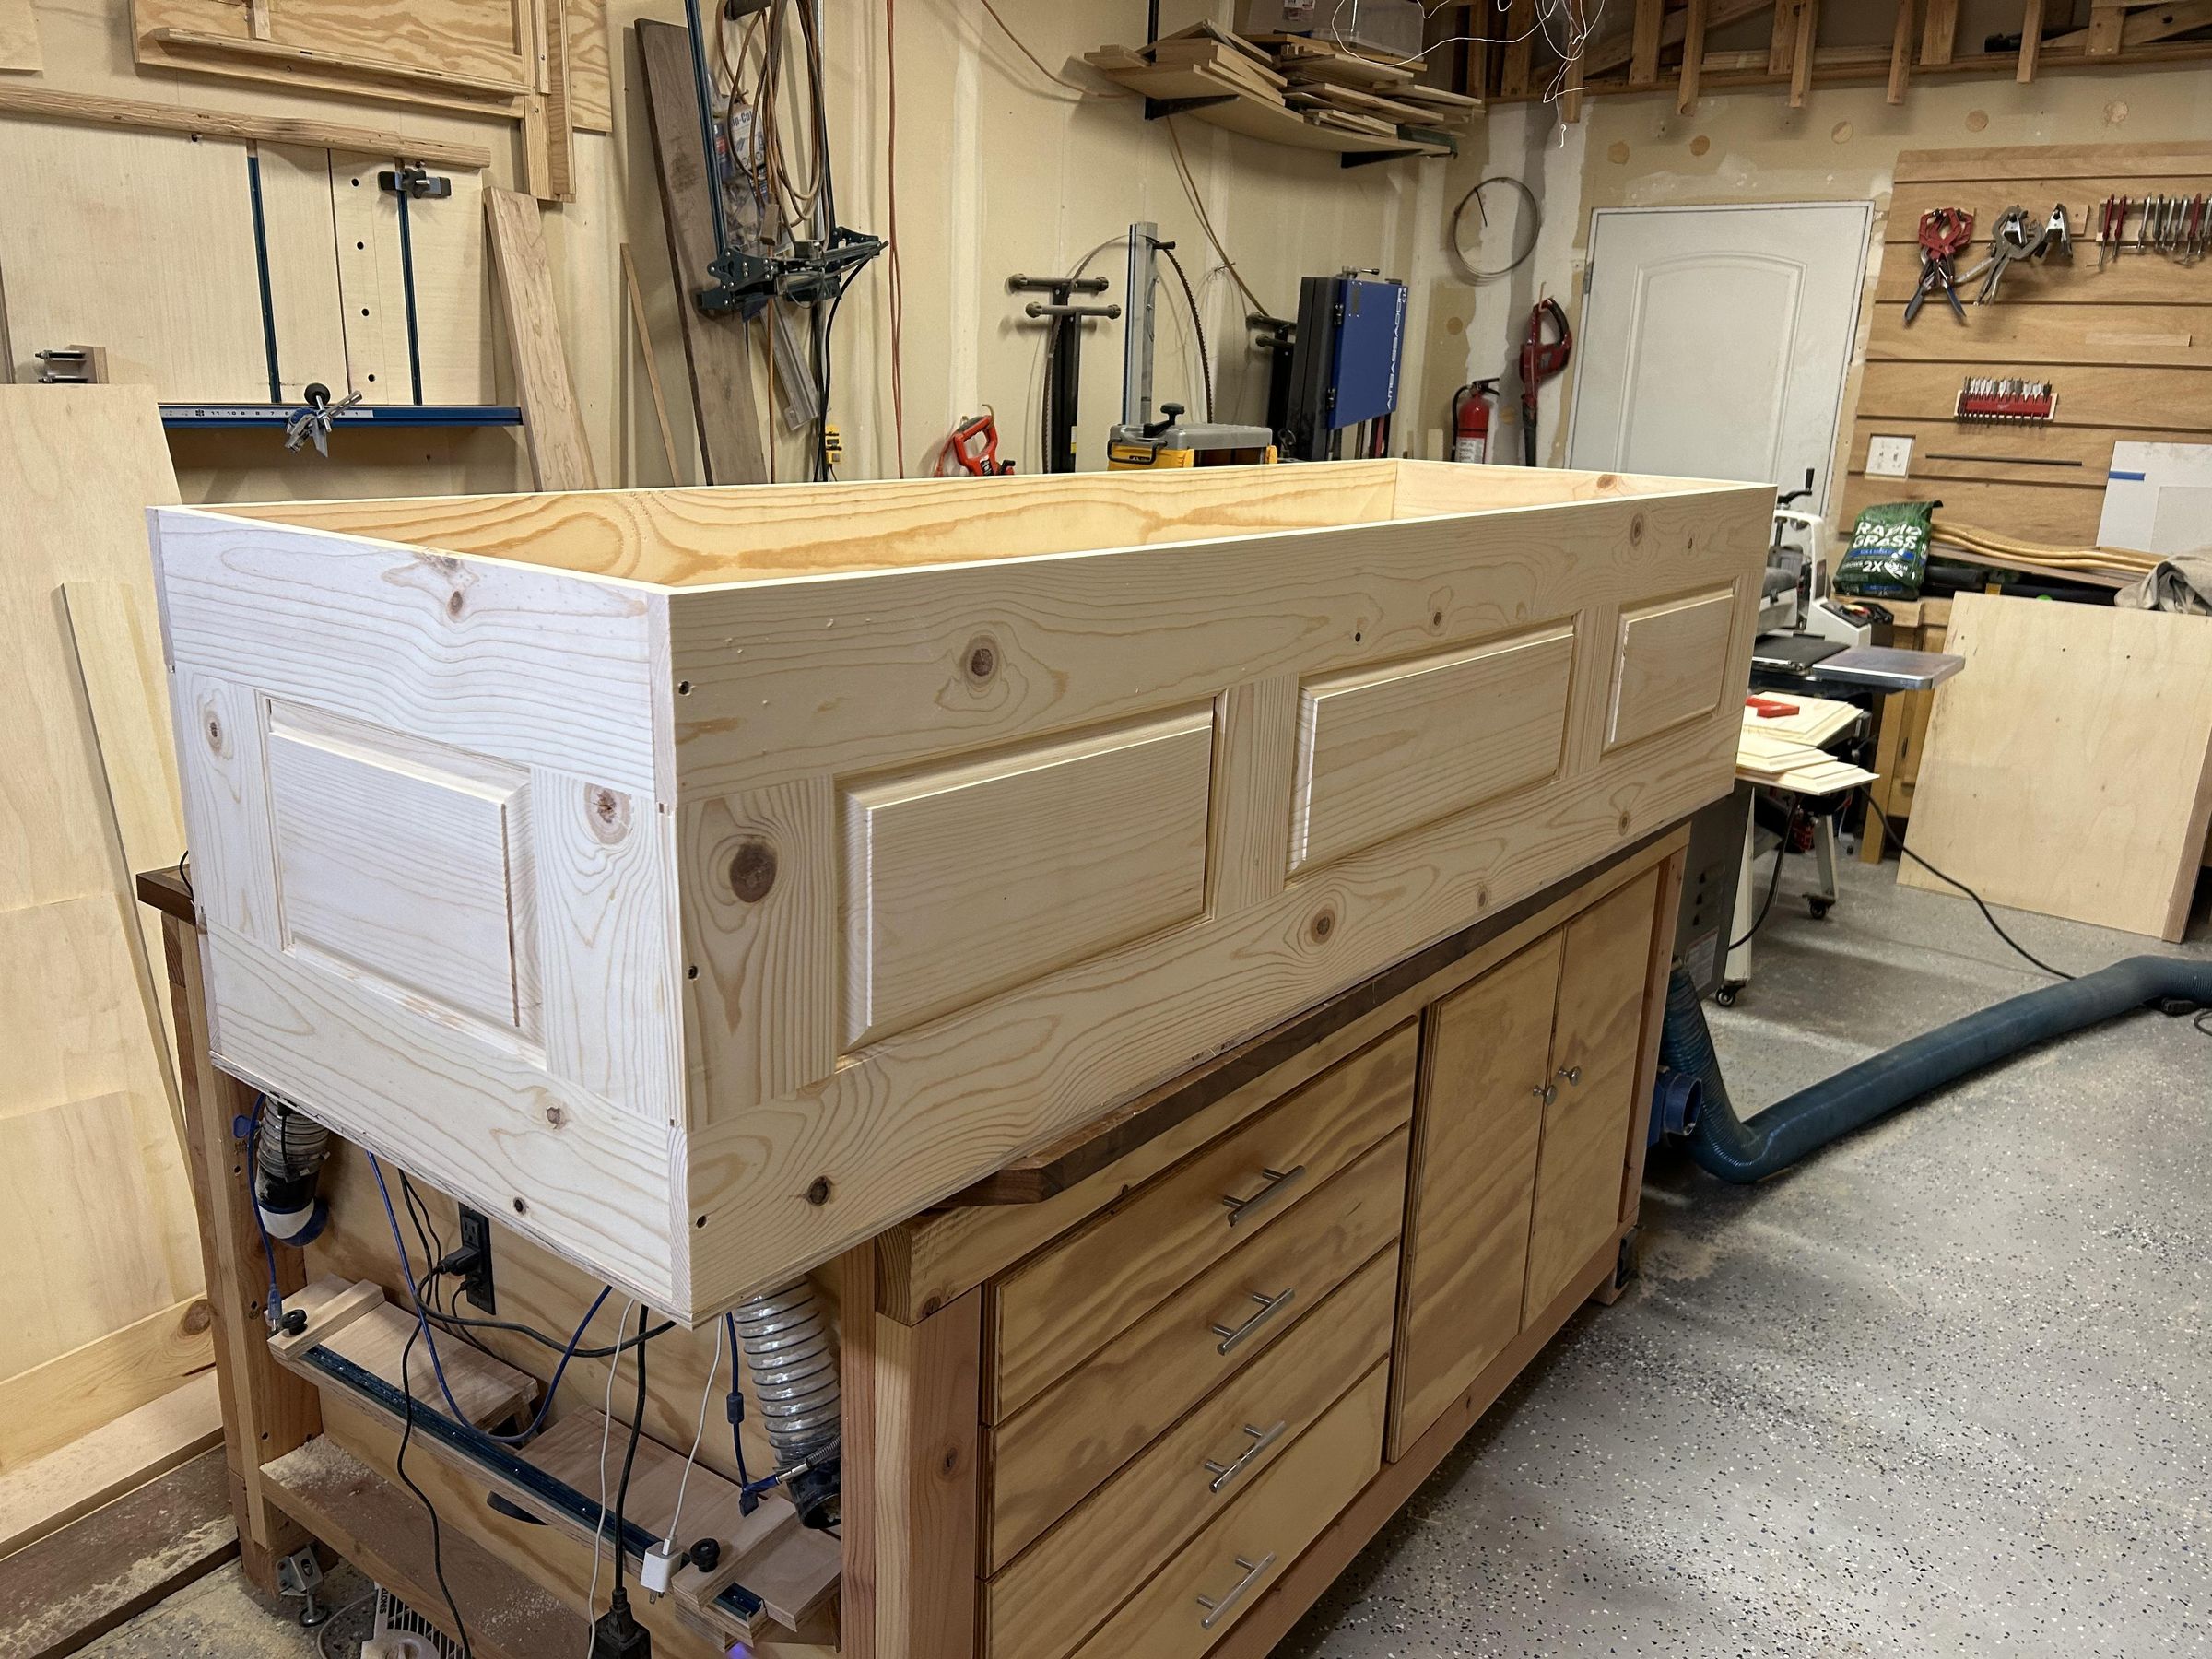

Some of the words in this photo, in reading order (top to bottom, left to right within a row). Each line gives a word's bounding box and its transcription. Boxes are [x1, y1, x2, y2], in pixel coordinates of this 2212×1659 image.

[1386, 287, 1402, 410] AMBASSADOR
[1853, 535, 1916, 550] GRASS
[1862, 560, 1884, 572] 2X
